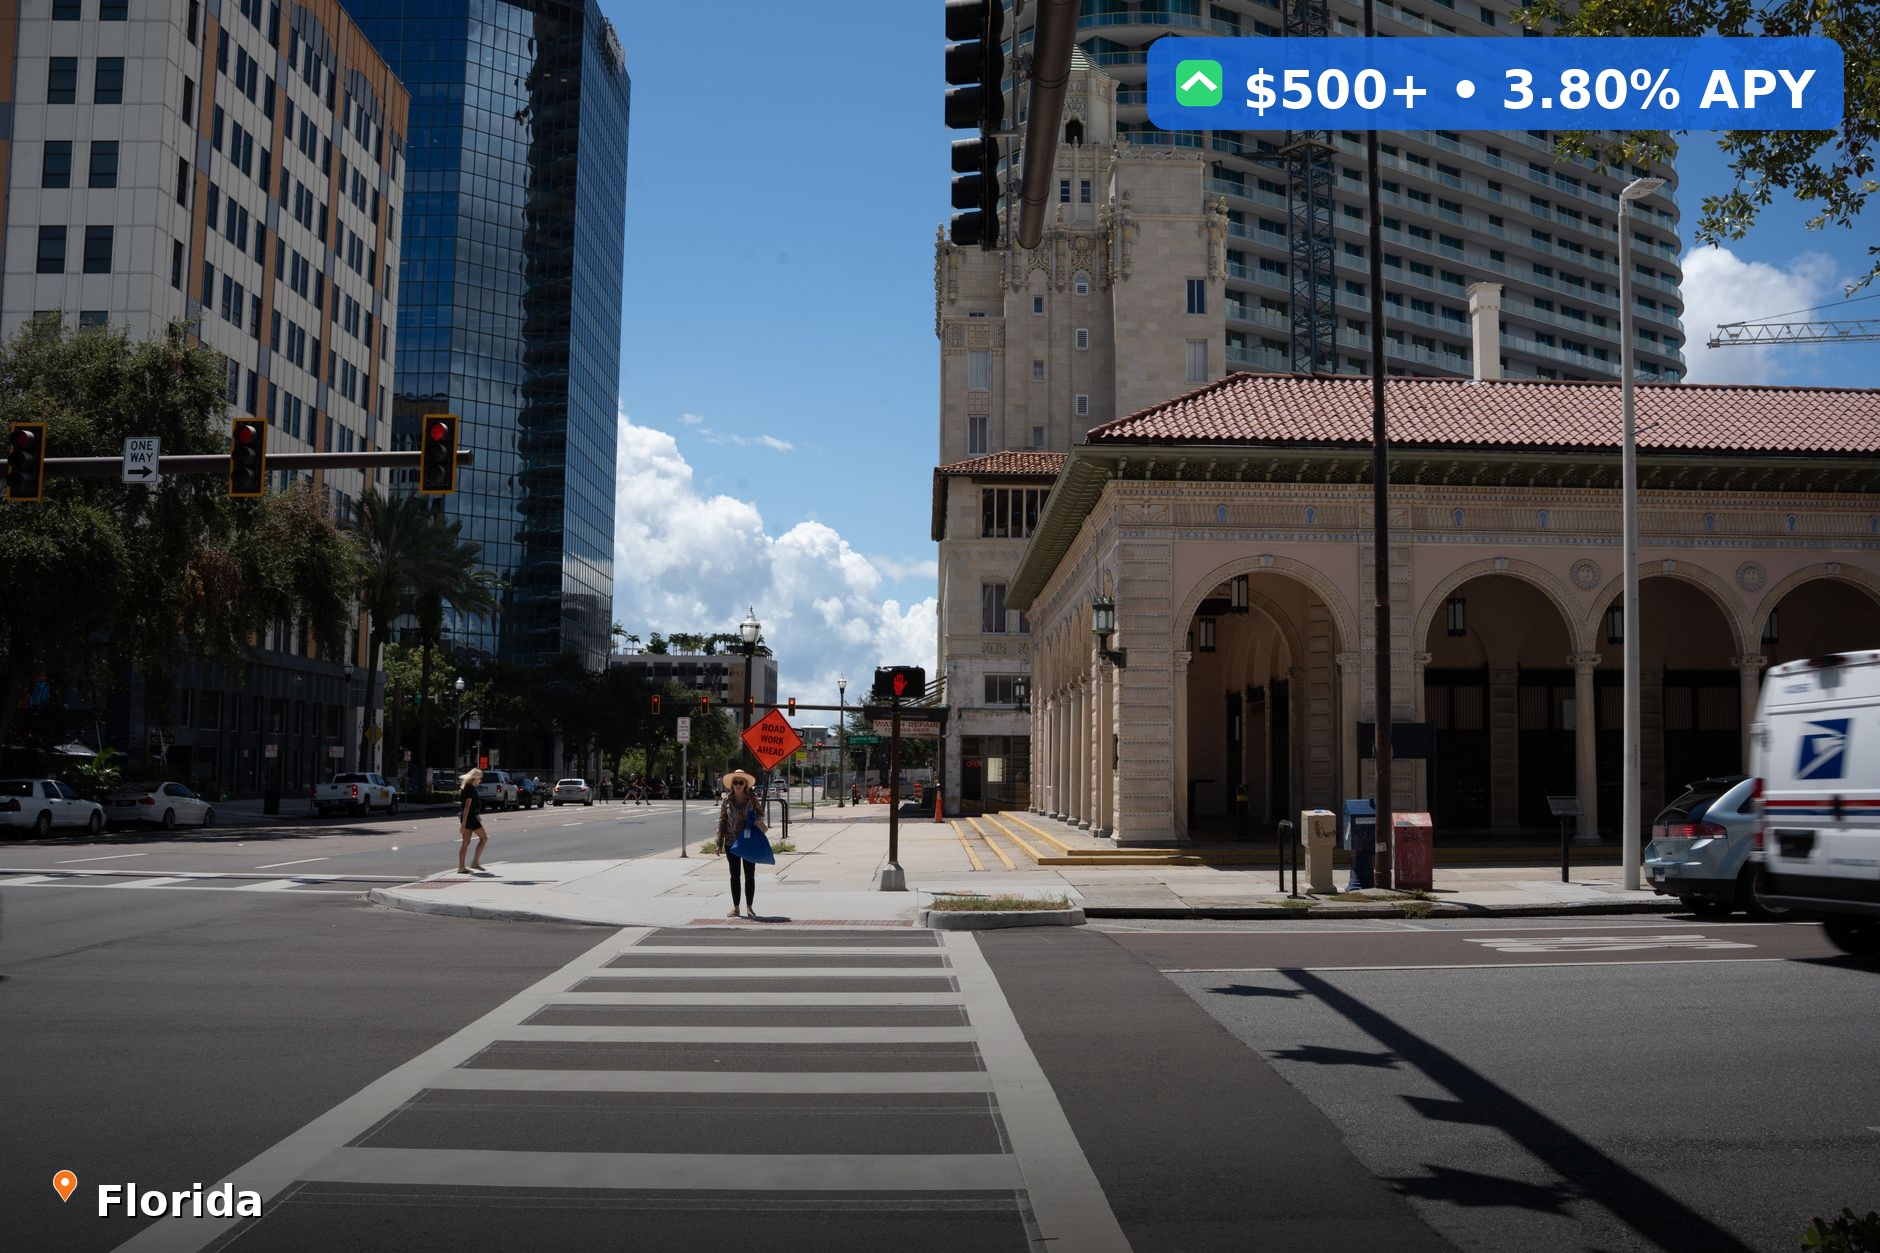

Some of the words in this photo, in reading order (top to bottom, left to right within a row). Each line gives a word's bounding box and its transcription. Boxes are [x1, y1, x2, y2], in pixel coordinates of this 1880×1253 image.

[130, 440, 153, 451] ONE
[130, 452, 153, 463] WAY
[761, 723, 786, 734] ROAD
[909, 721, 938, 729] REPAIR
[760, 734, 784, 745] WORK
[757, 745, 785, 757] AHEAD
